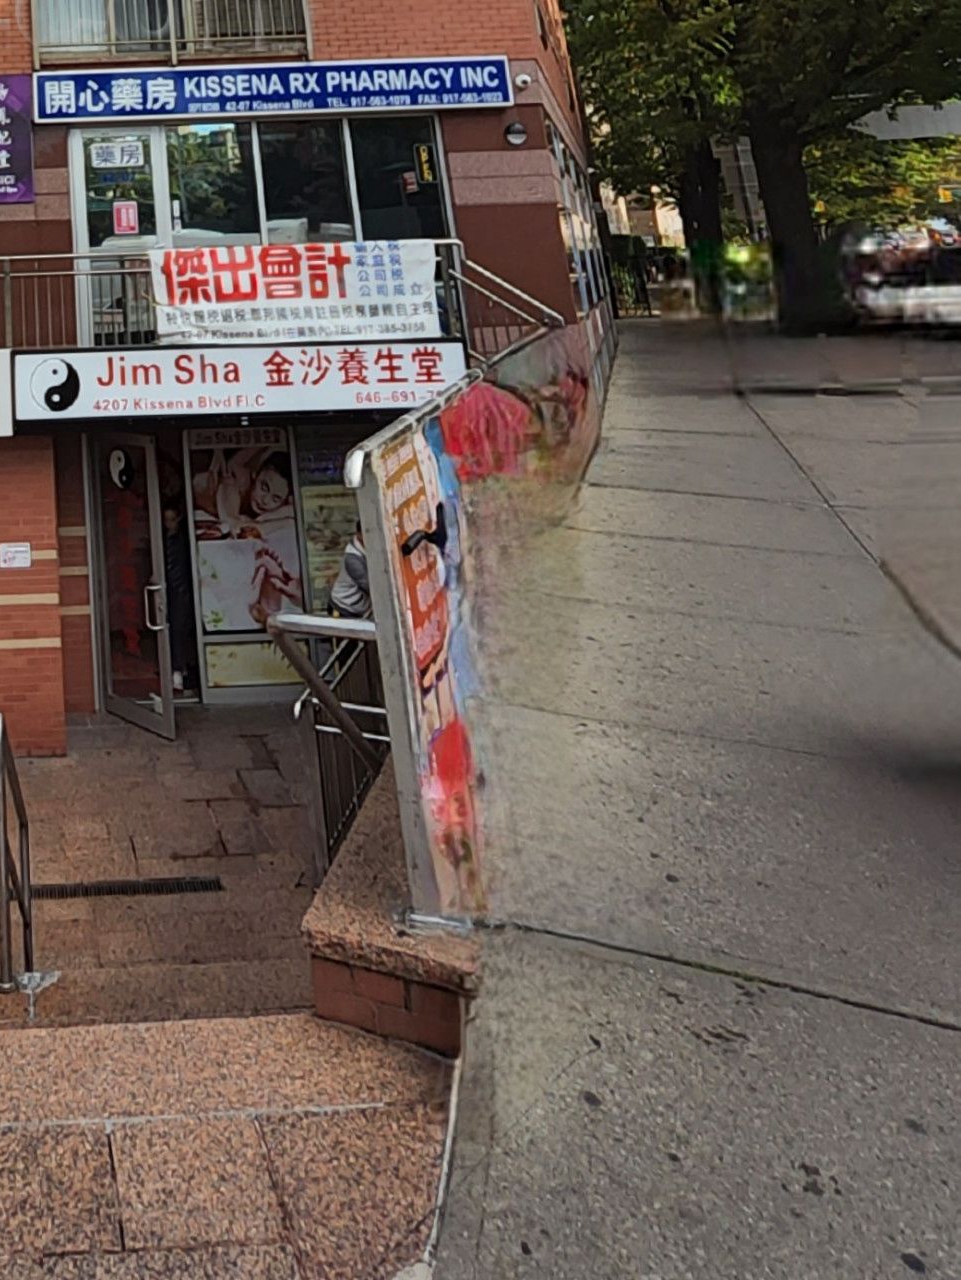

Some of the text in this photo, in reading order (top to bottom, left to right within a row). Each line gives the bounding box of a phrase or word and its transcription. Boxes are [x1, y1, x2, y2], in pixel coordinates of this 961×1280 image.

[44, 77, 177, 115] 開心藥房
[184, 66, 500, 99] KISSENA RX PHARMACY INC
[292, 98, 314, 109] Blvd
[94, 145, 141, 165] 藥房
[161, 242, 352, 306] 傑出會計
[96, 346, 445, 387] Jim Sha 金沙養生堂
[93, 399, 128, 411] 4207
[133, 397, 193, 410] Kissena
[198, 395, 232, 408] Blvd
